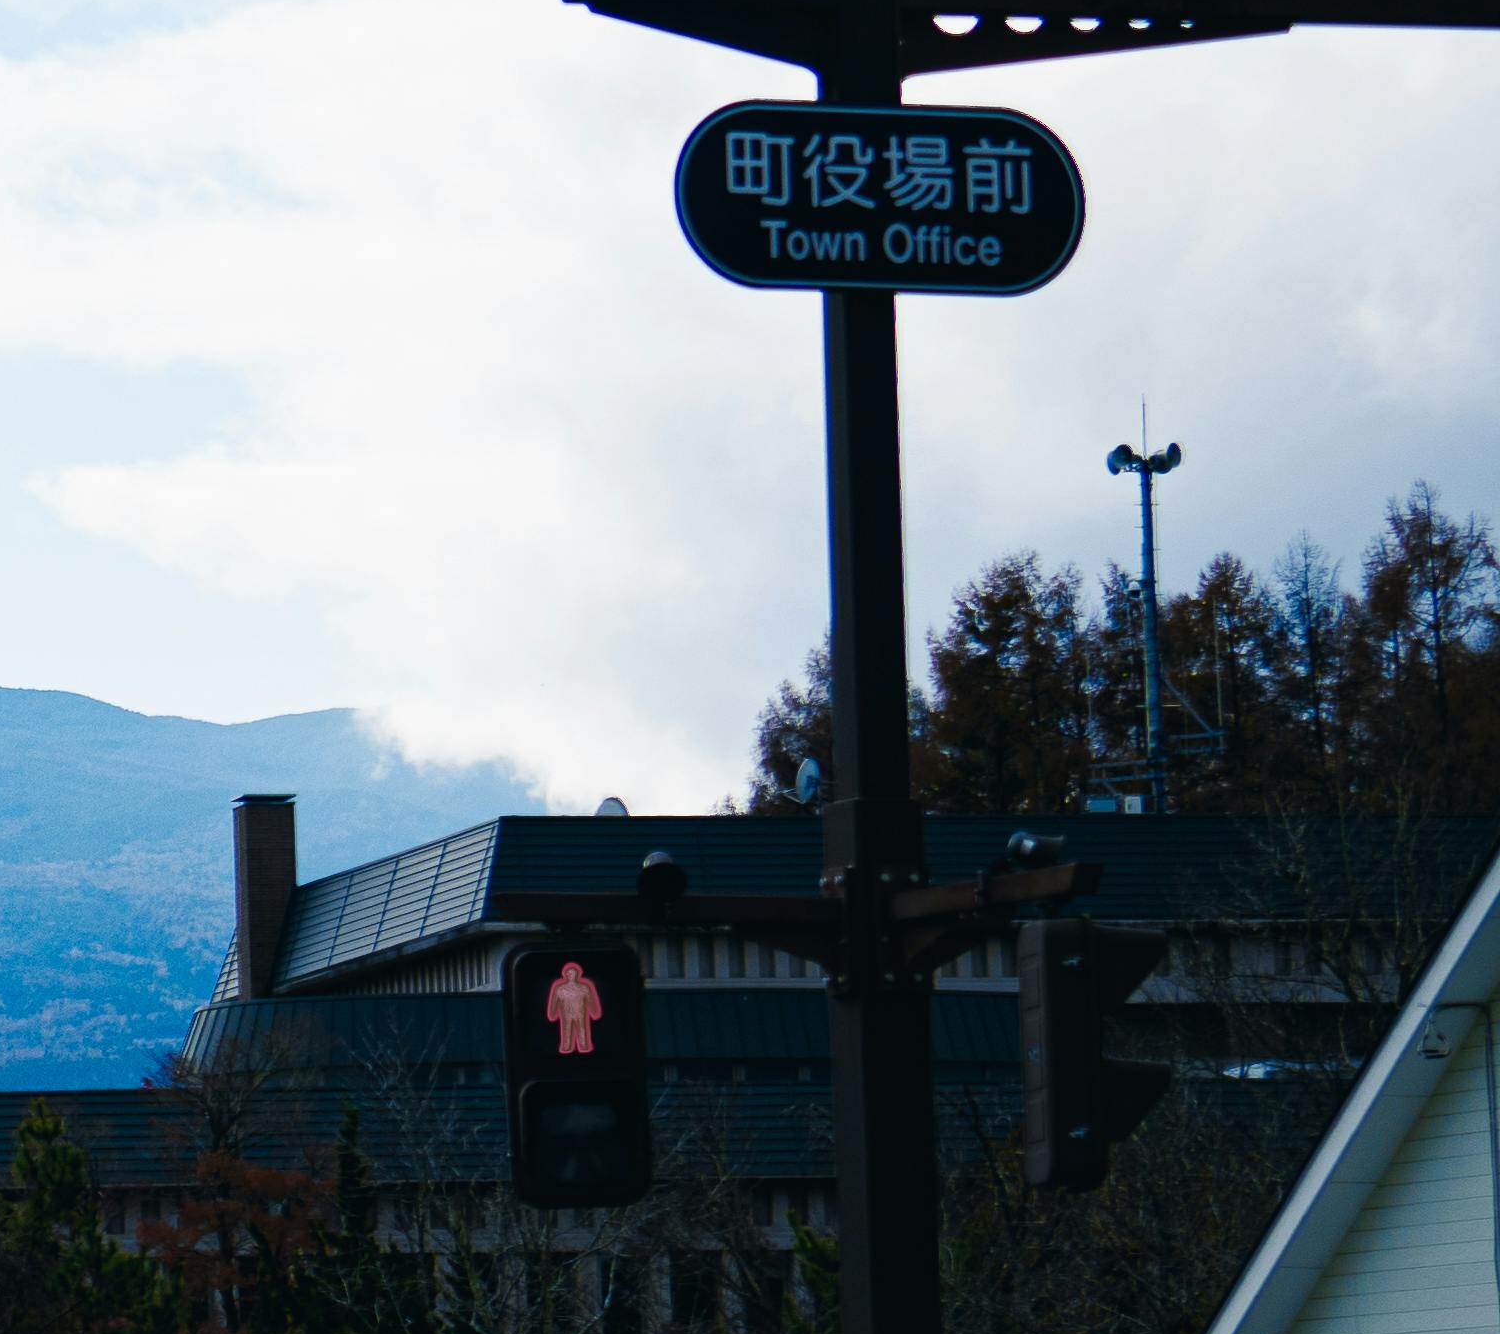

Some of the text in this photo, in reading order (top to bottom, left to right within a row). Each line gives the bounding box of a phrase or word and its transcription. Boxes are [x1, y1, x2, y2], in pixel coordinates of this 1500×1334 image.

[724, 131, 1032, 215] 町役場前
[760, 220, 1001, 266] Town Office
